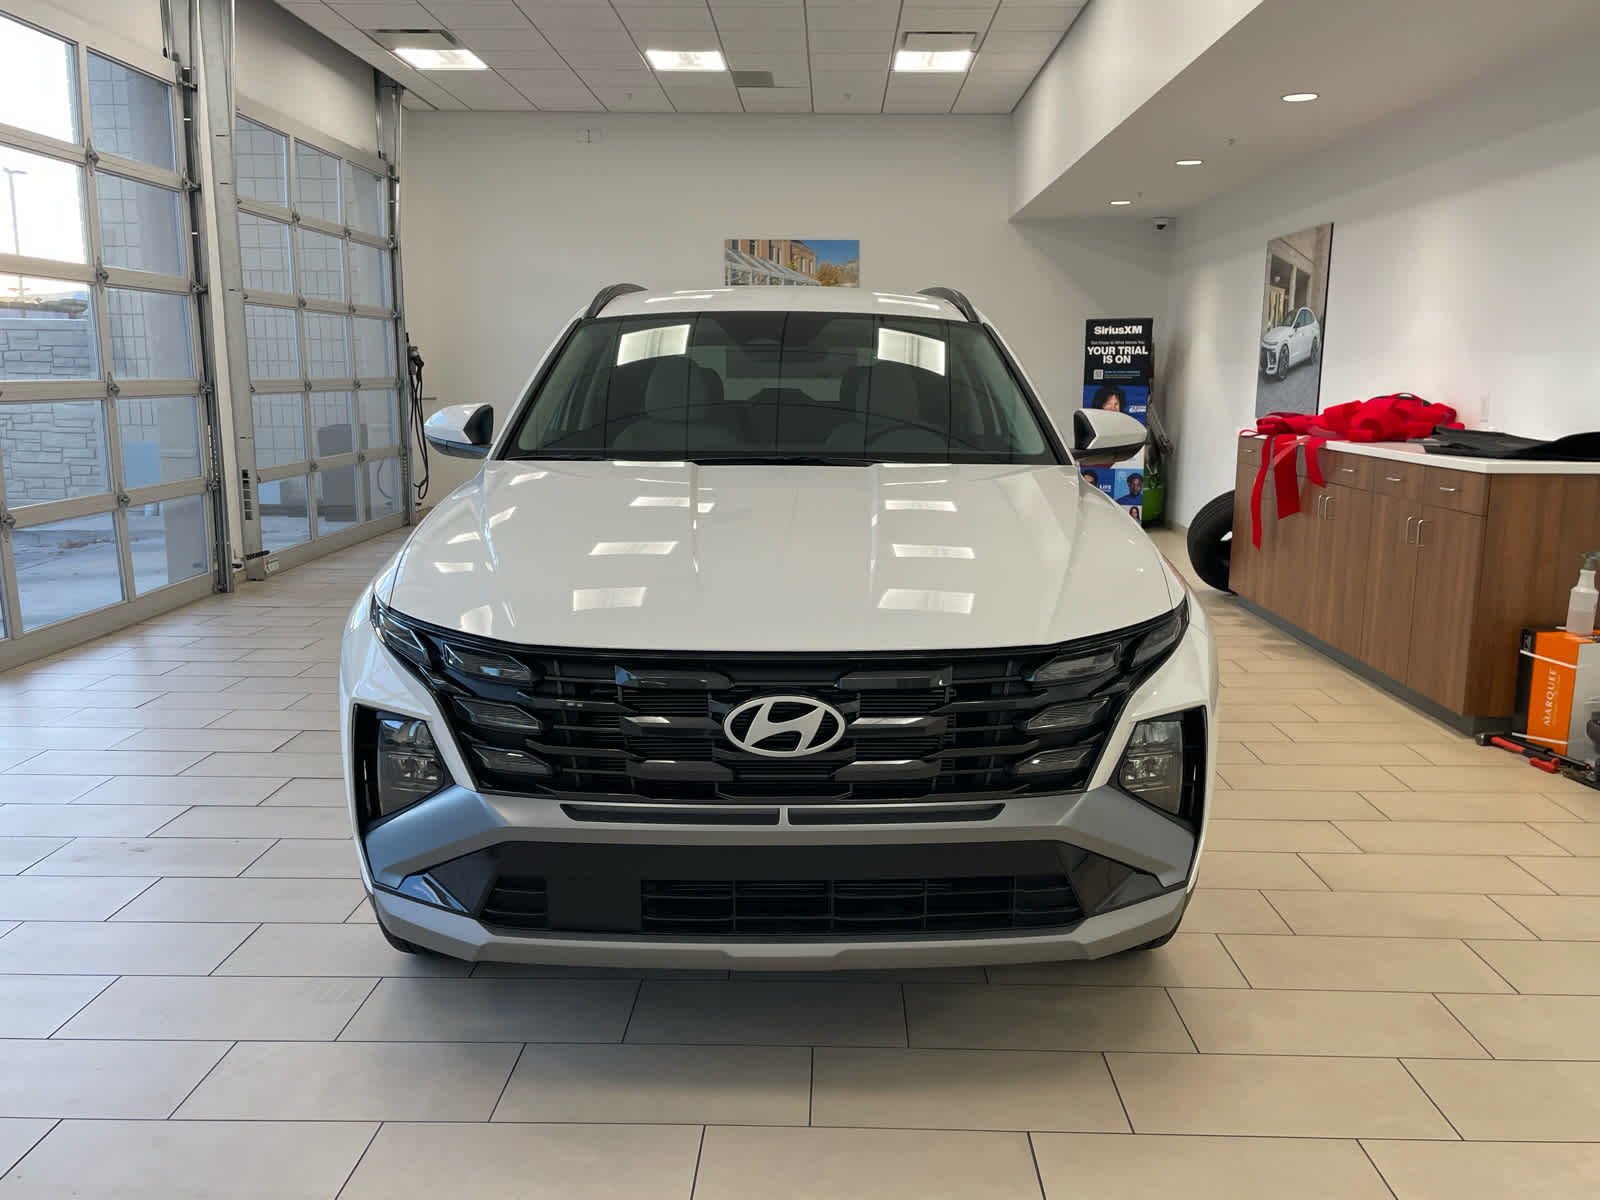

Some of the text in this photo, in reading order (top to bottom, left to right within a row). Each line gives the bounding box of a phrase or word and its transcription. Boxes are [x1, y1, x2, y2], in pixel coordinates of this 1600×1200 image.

[1094, 325, 1143, 335] SiriusXM
[1087, 345, 1149, 355] YOUR TRIAL
[1103, 355, 1131, 364] IS ON
